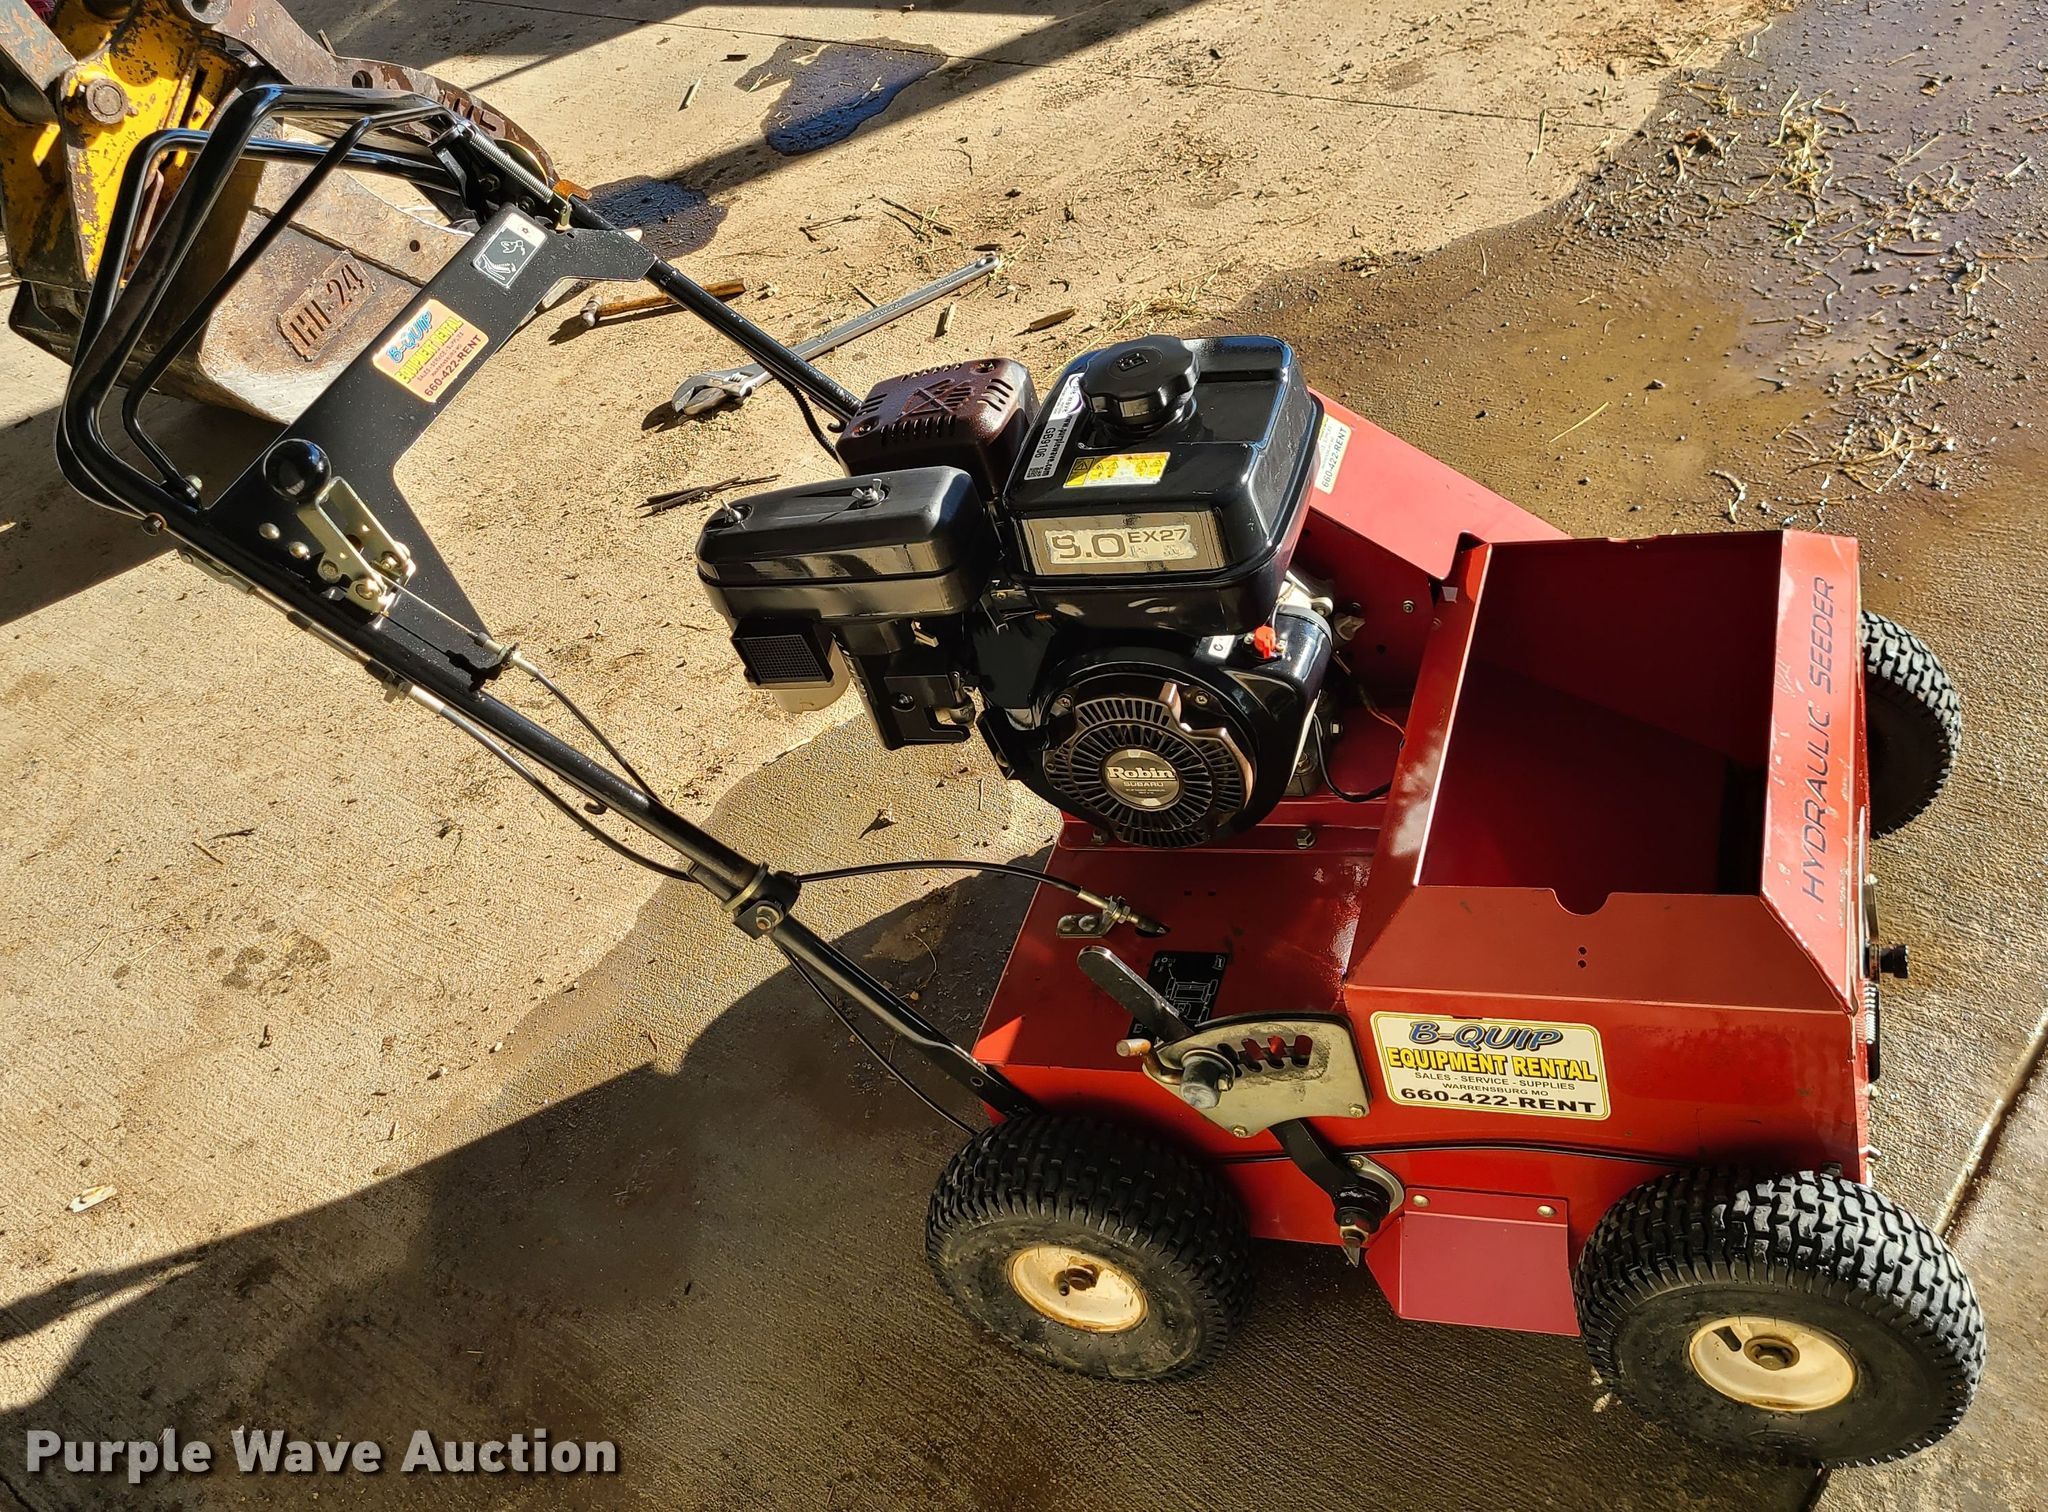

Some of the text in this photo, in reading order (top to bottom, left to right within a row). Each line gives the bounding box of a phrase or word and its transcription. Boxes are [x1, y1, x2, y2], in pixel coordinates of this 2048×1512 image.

[387, 310, 433, 363] B-QUIP
[394, 315, 464, 384] EQUIPMENT RENTAL
[424, 334, 482, 397] 660-422-RENT
[1034, 427, 1056, 459] GB9106
[1321, 426, 1348, 488] 660-422-RENT
[1127, 528, 1187, 543] EX27
[1801, 576, 1835, 904] HYDRAULIC SEEDER
[1106, 766, 1177, 781] Robin
[1408, 1020, 1563, 1051] B-QUIP
[1386, 1046, 1598, 1082] EQUIPMENT RENTAL
[1415, 1071, 1451, 1082] SALES
[1461, 1075, 1510, 1086] SERVICE
[1519, 1079, 1576, 1091] SUPPLIES
[1442, 1083, 1529, 1096] WARRENSBURG
[1400, 1088, 1597, 1113] 660-422-RENT
